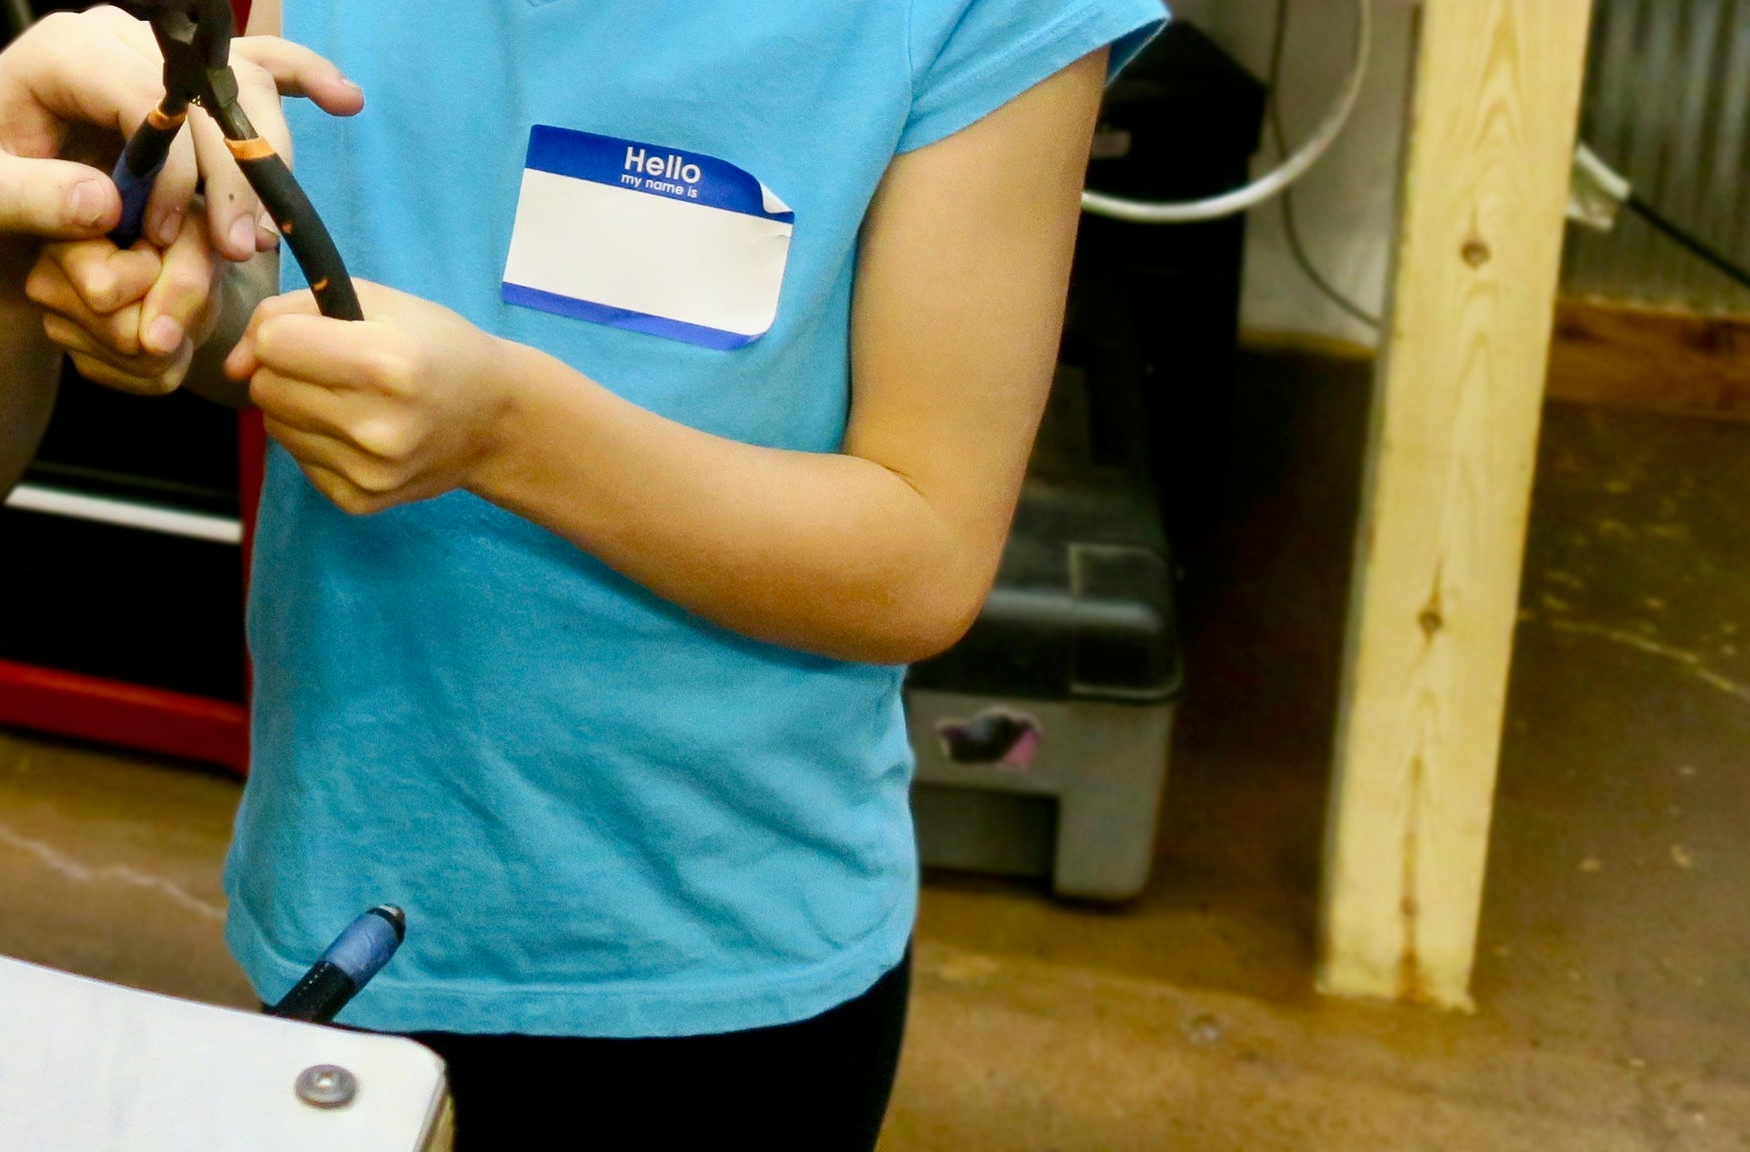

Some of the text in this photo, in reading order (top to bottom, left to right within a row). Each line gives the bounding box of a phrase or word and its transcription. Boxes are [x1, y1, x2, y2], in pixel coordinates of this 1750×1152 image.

[624, 146, 701, 184] Hello
[621, 174, 698, 198] my name is
